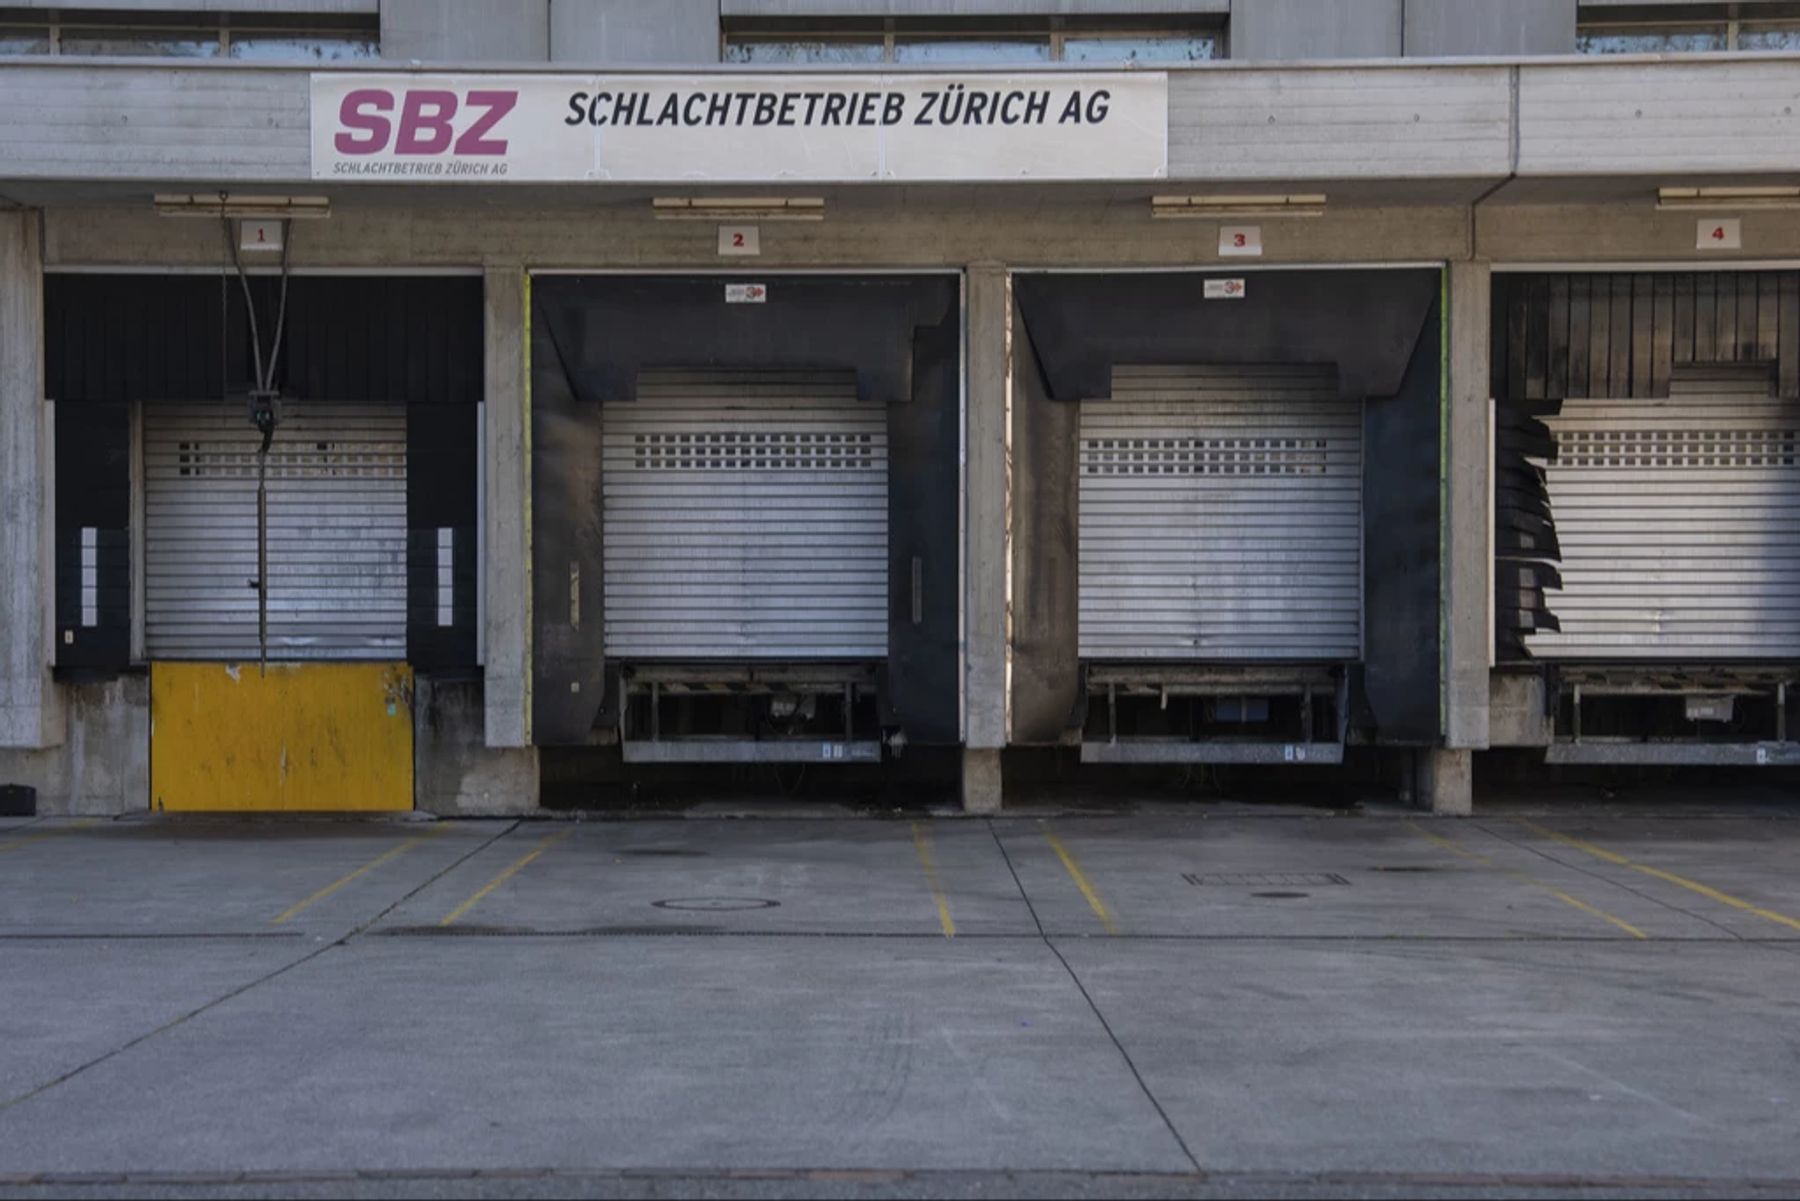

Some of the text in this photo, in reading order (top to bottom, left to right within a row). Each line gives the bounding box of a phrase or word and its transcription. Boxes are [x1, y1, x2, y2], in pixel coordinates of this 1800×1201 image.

[564, 83, 1111, 126] SCHLACHTBETRIEB ZÜRICH AG
[334, 88, 519, 156] SBZ
[333, 160, 508, 176] SCHLACHTBETRIEB ZÜRICH AG
[256, 228, 266, 243] 1
[732, 232, 745, 248] 2
[1233, 232, 1247, 248] 3
[1711, 226, 1725, 241] 4
